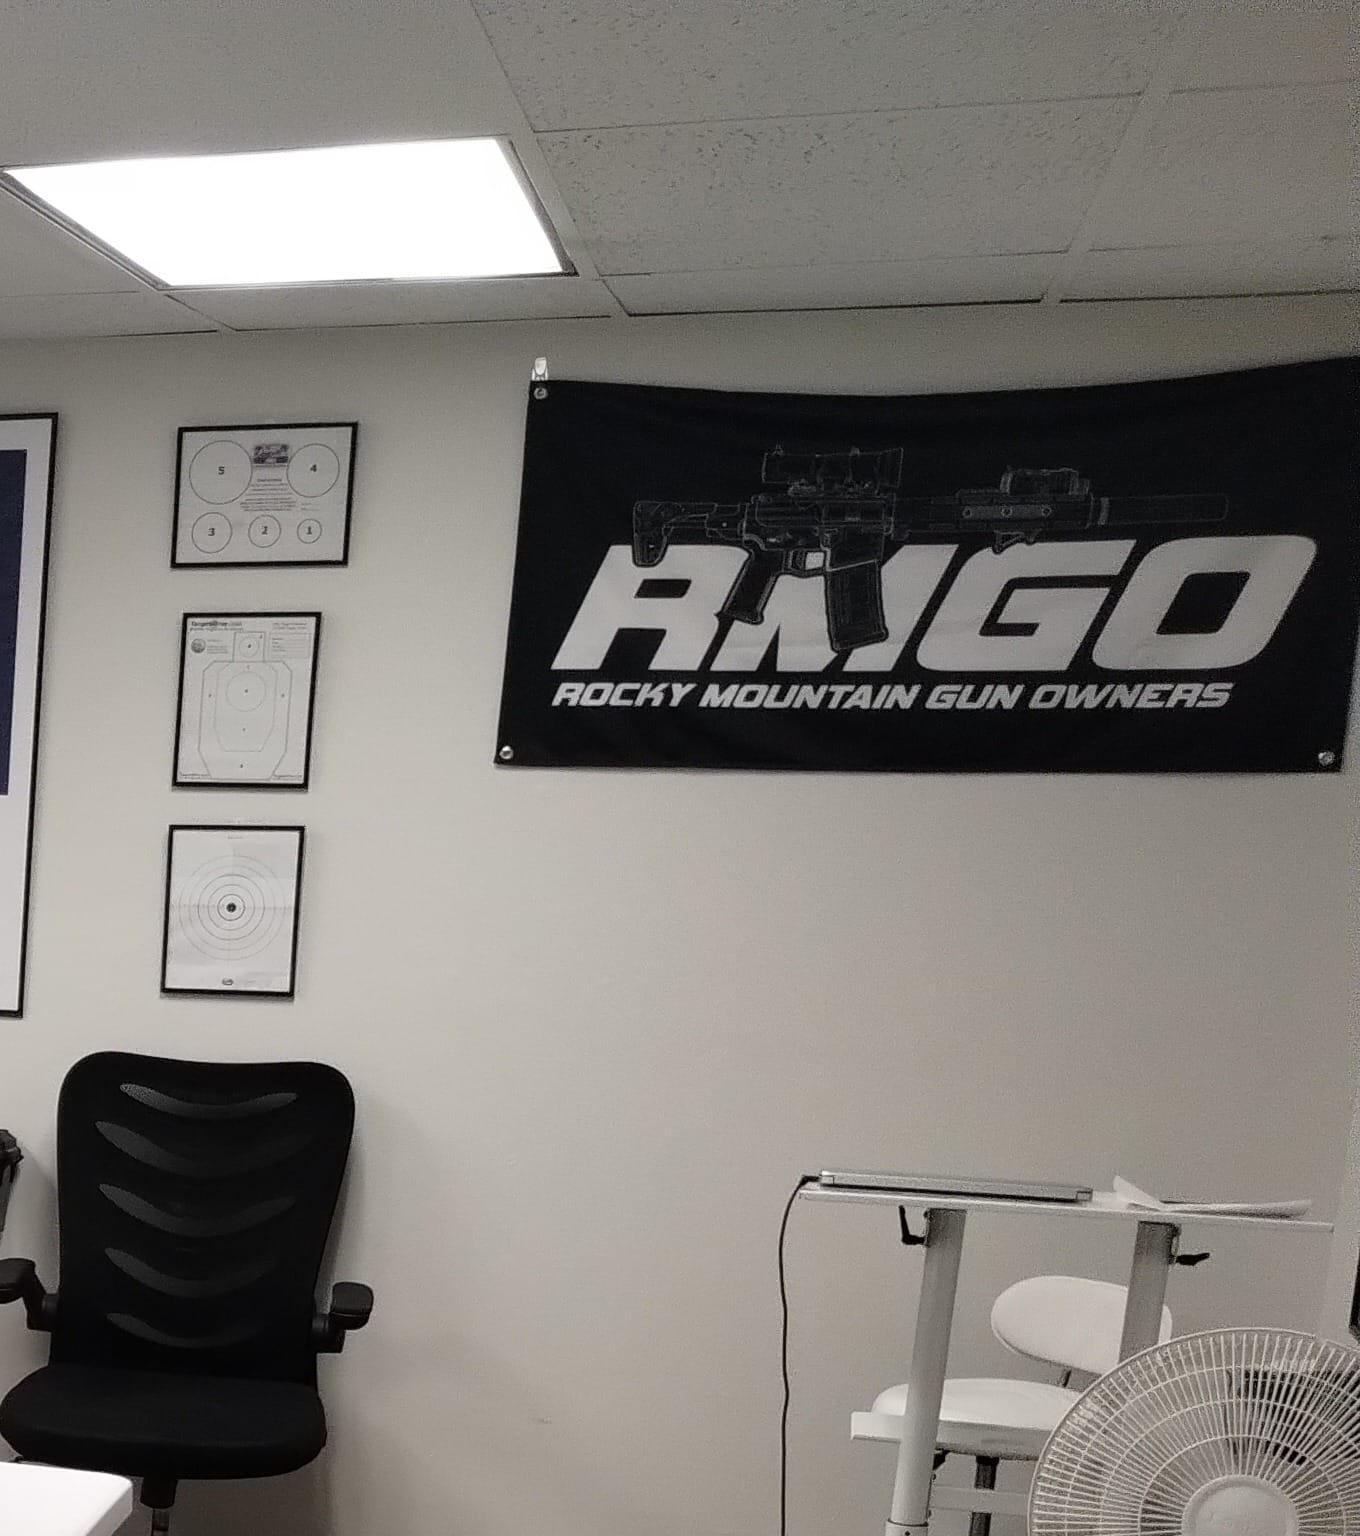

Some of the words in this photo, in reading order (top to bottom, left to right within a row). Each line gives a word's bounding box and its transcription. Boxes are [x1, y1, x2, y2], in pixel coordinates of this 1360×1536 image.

[219, 467, 224, 475] 5
[208, 528, 215, 536] 3
[262, 526, 268, 534] 2
[306, 527, 312, 535] 1
[552, 682, 698, 710] ROCKY
[699, 683, 915, 711] MOUNTAIN
[918, 684, 1029, 710] GUN
[1026, 682, 1235, 710] OWNERS
